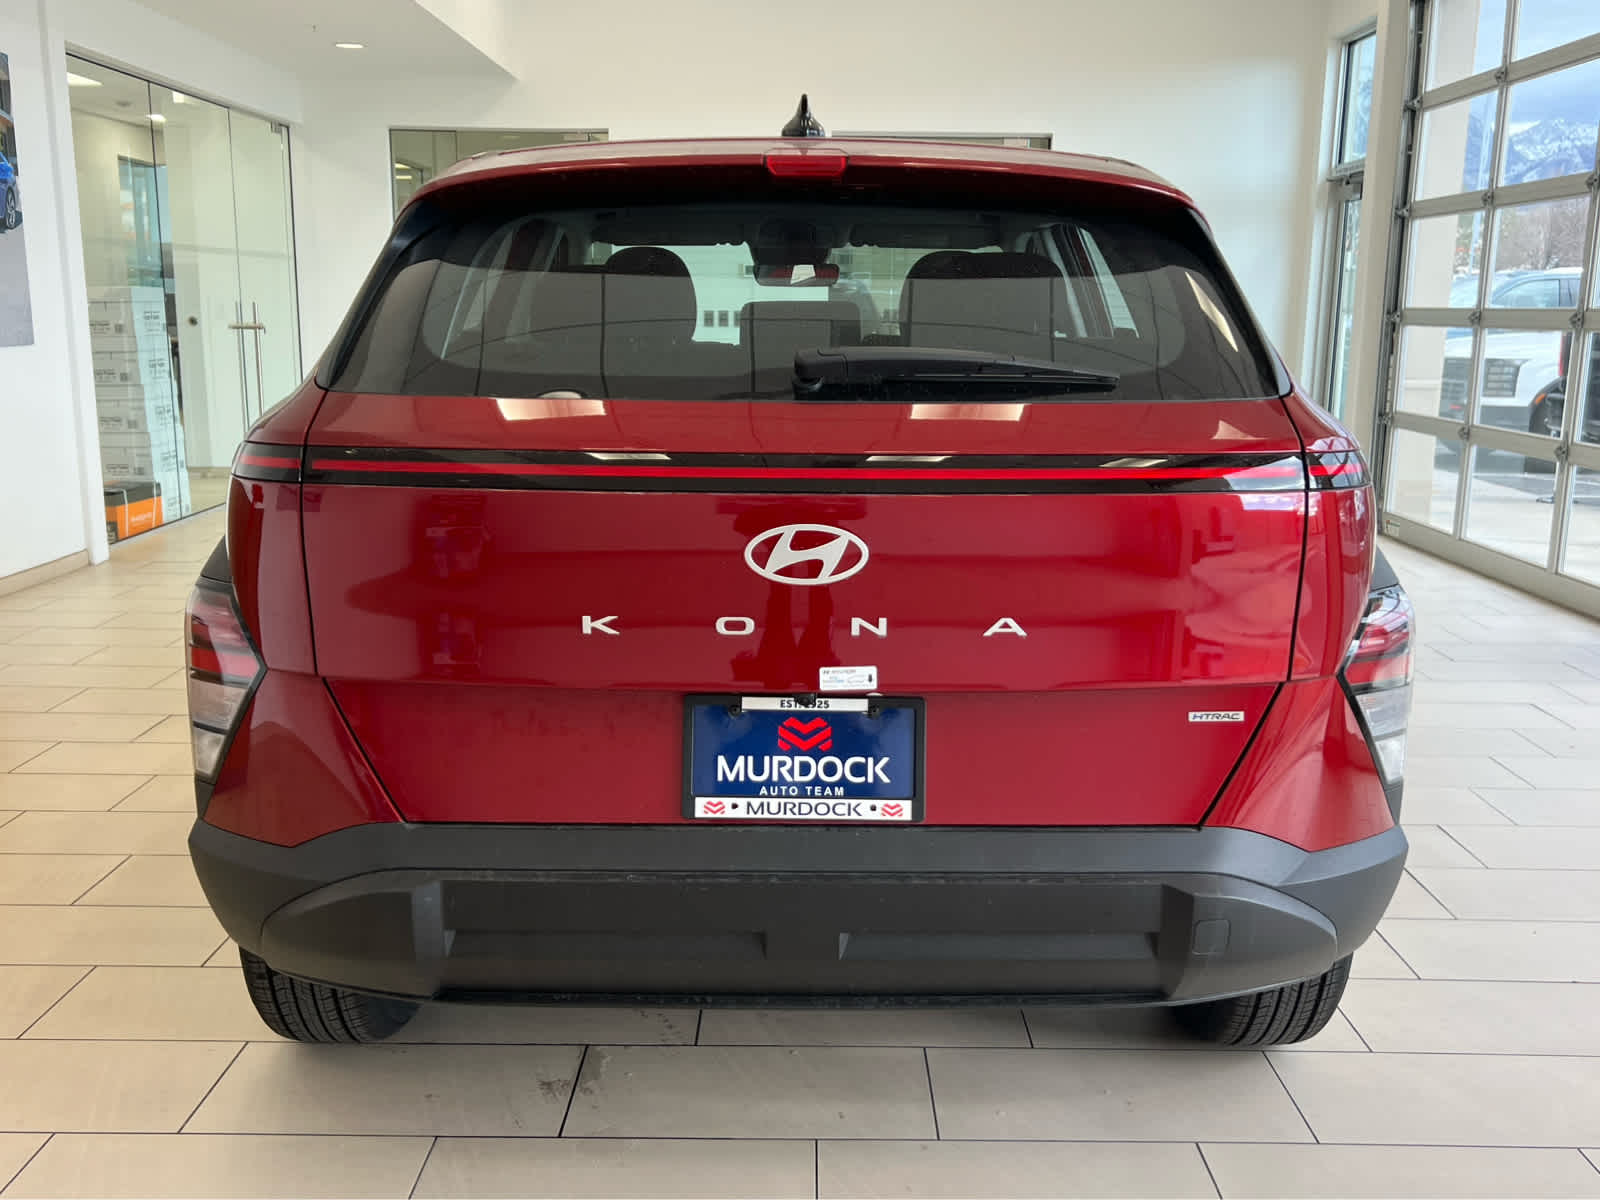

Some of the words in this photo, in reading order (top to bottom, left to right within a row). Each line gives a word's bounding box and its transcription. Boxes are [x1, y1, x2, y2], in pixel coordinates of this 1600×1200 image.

[581, 615, 1027, 638] KONA
[1191, 712, 1241, 720] HTRAC
[717, 755, 891, 783] MURDOCK
[759, 786, 798, 796] AUTO
[805, 786, 845, 797] TEAM
[746, 801, 863, 817] MURDOCK
